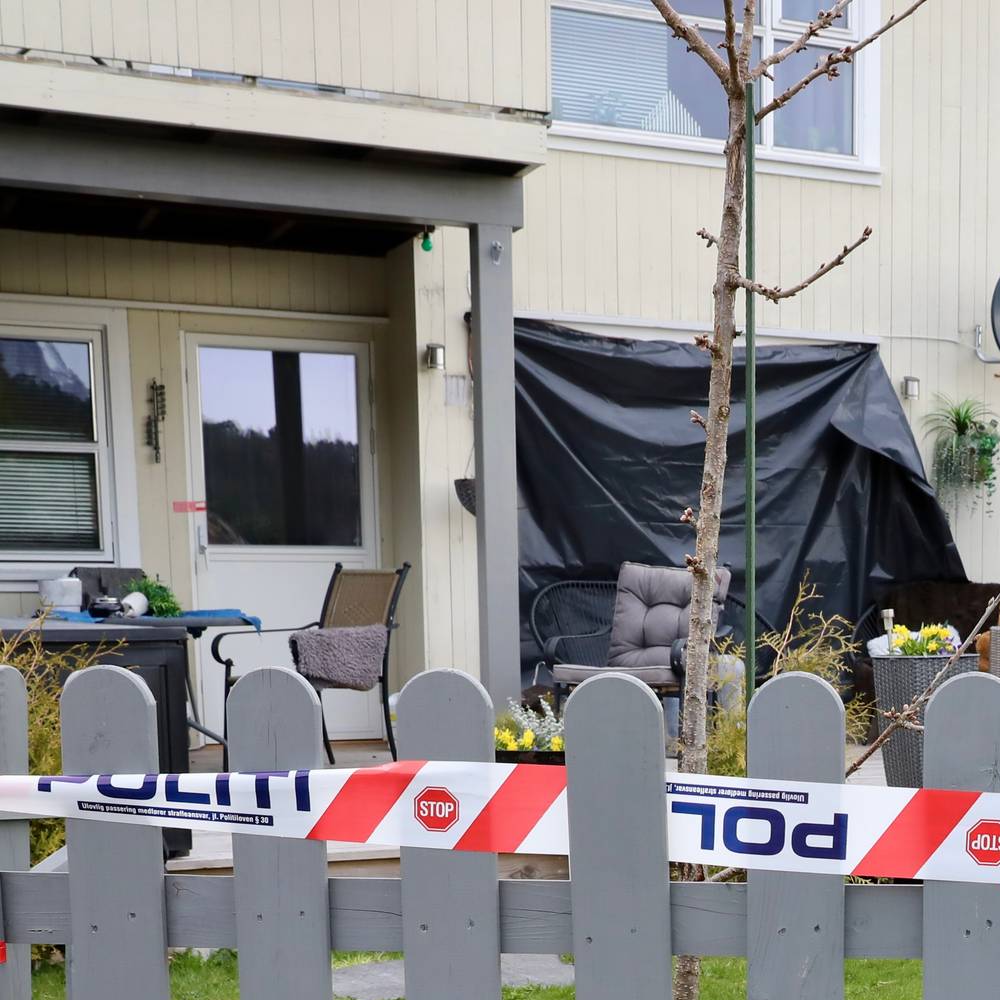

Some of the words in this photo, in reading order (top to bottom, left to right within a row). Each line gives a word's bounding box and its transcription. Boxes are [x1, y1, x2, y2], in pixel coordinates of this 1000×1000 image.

[748, 790, 780, 800] passering
[782, 792, 805, 802] Ulovlig
[81, 802, 105, 811] Ulovlig
[105, 805, 137, 814] passering
[168, 810, 211, 820] straffeansvar,
[219, 813, 254, 823] Politiloven
[260, 816, 269, 824] 30
[419, 801, 454, 818] STOP
[671, 801, 849, 860] POL
